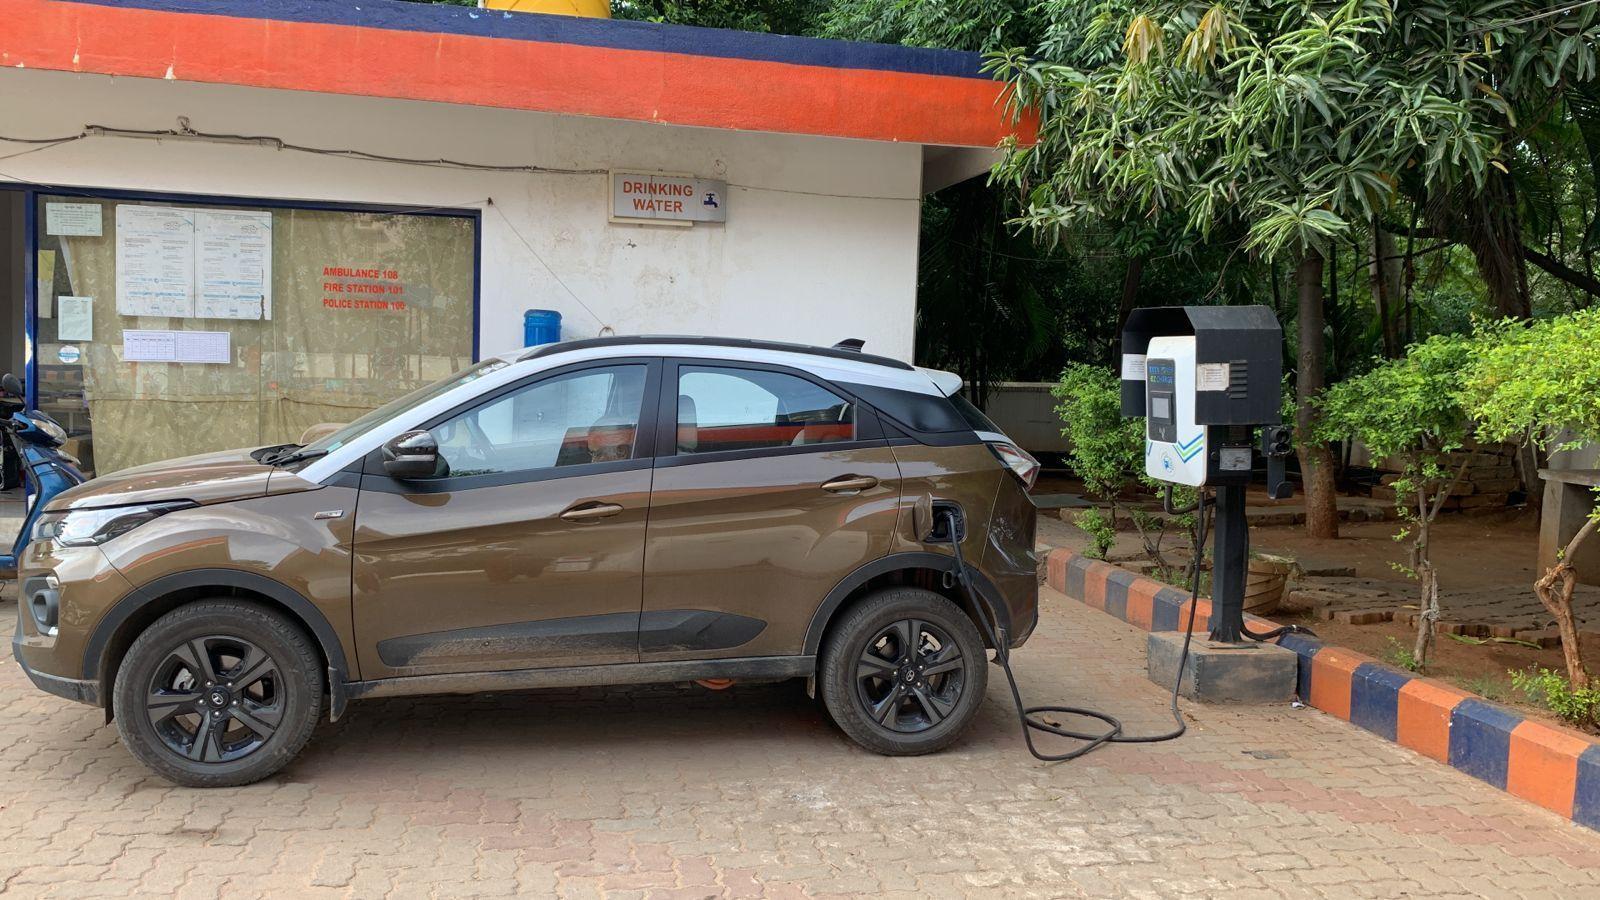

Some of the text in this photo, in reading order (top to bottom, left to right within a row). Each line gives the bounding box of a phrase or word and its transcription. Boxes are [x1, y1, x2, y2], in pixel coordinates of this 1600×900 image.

[623, 181, 693, 197] DRINKING
[633, 198, 683, 213] WATER
[323, 267, 399, 280] AMBULANCE 108
[323, 283, 404, 294] FIRE STATION 101
[323, 298, 352, 309] POLICE
[354, 301, 388, 310] STATION
